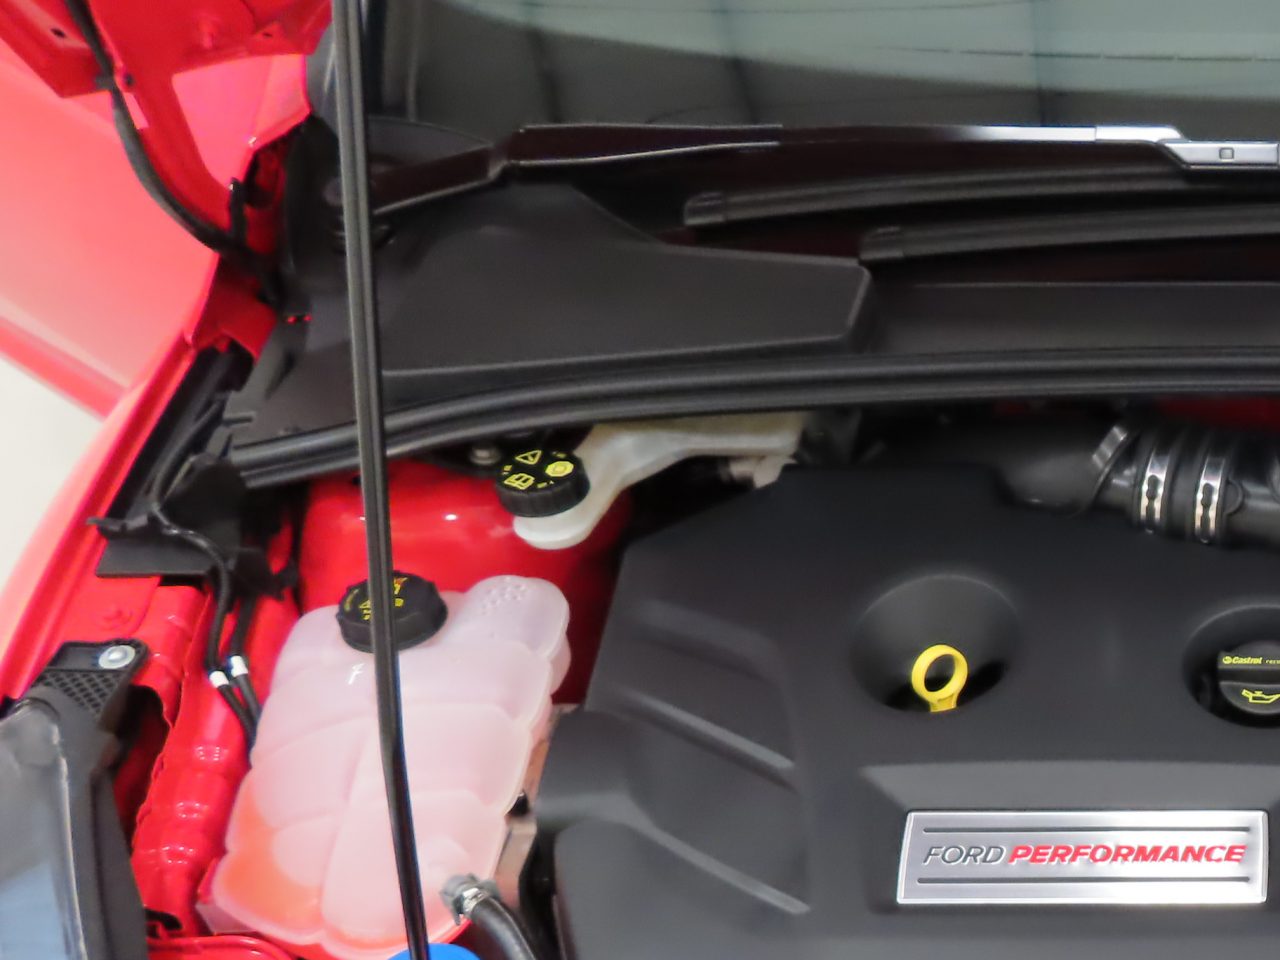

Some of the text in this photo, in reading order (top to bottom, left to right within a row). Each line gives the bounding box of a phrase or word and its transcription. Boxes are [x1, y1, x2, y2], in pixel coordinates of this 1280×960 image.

[1232, 656, 1263, 665] Castrol
[923, 844, 1247, 864] FORD PERFORMANCE
